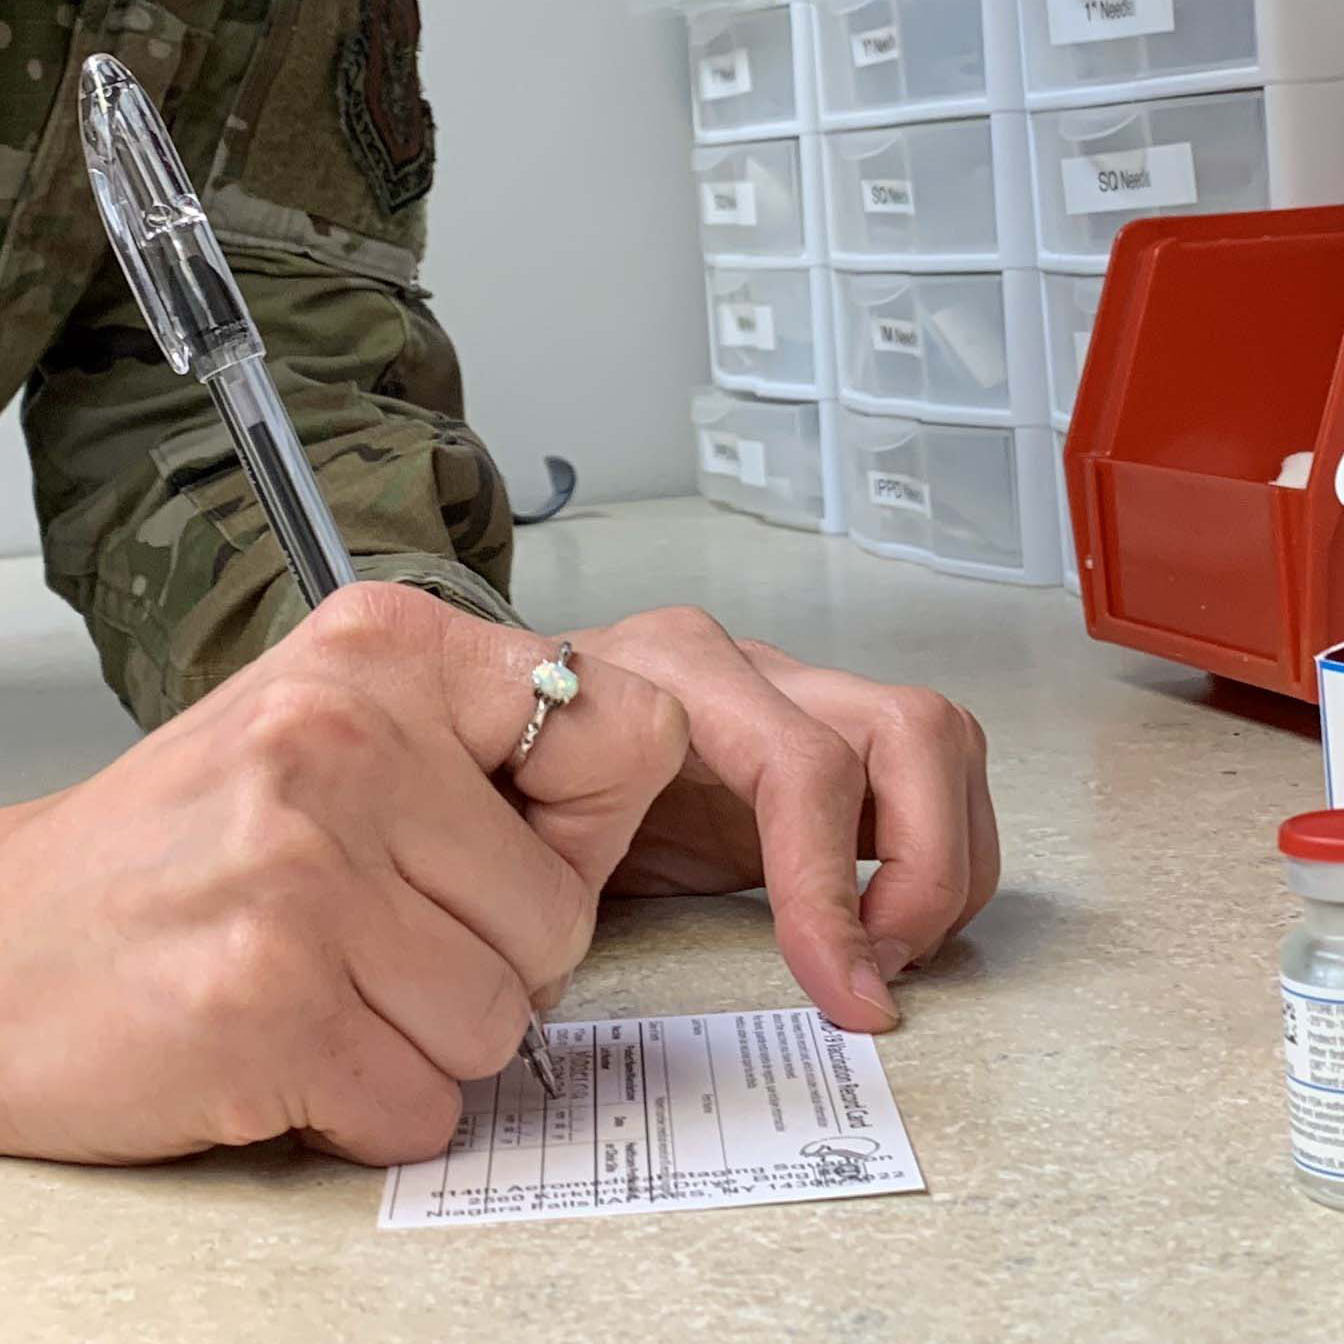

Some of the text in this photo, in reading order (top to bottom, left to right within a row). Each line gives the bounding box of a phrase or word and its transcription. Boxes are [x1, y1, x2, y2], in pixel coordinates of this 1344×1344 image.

[825, 1042, 853, 1084] Vaccination
[840, 1083, 867, 1110] Record
[846, 1109, 873, 1129] Card
[671, 1163, 765, 1179] Staging
[673, 1178, 737, 1190] Drive
[426, 1203, 522, 1218] Niagara
[531, 1199, 590, 1211] Falls
[722, 1184, 756, 1196] NY
